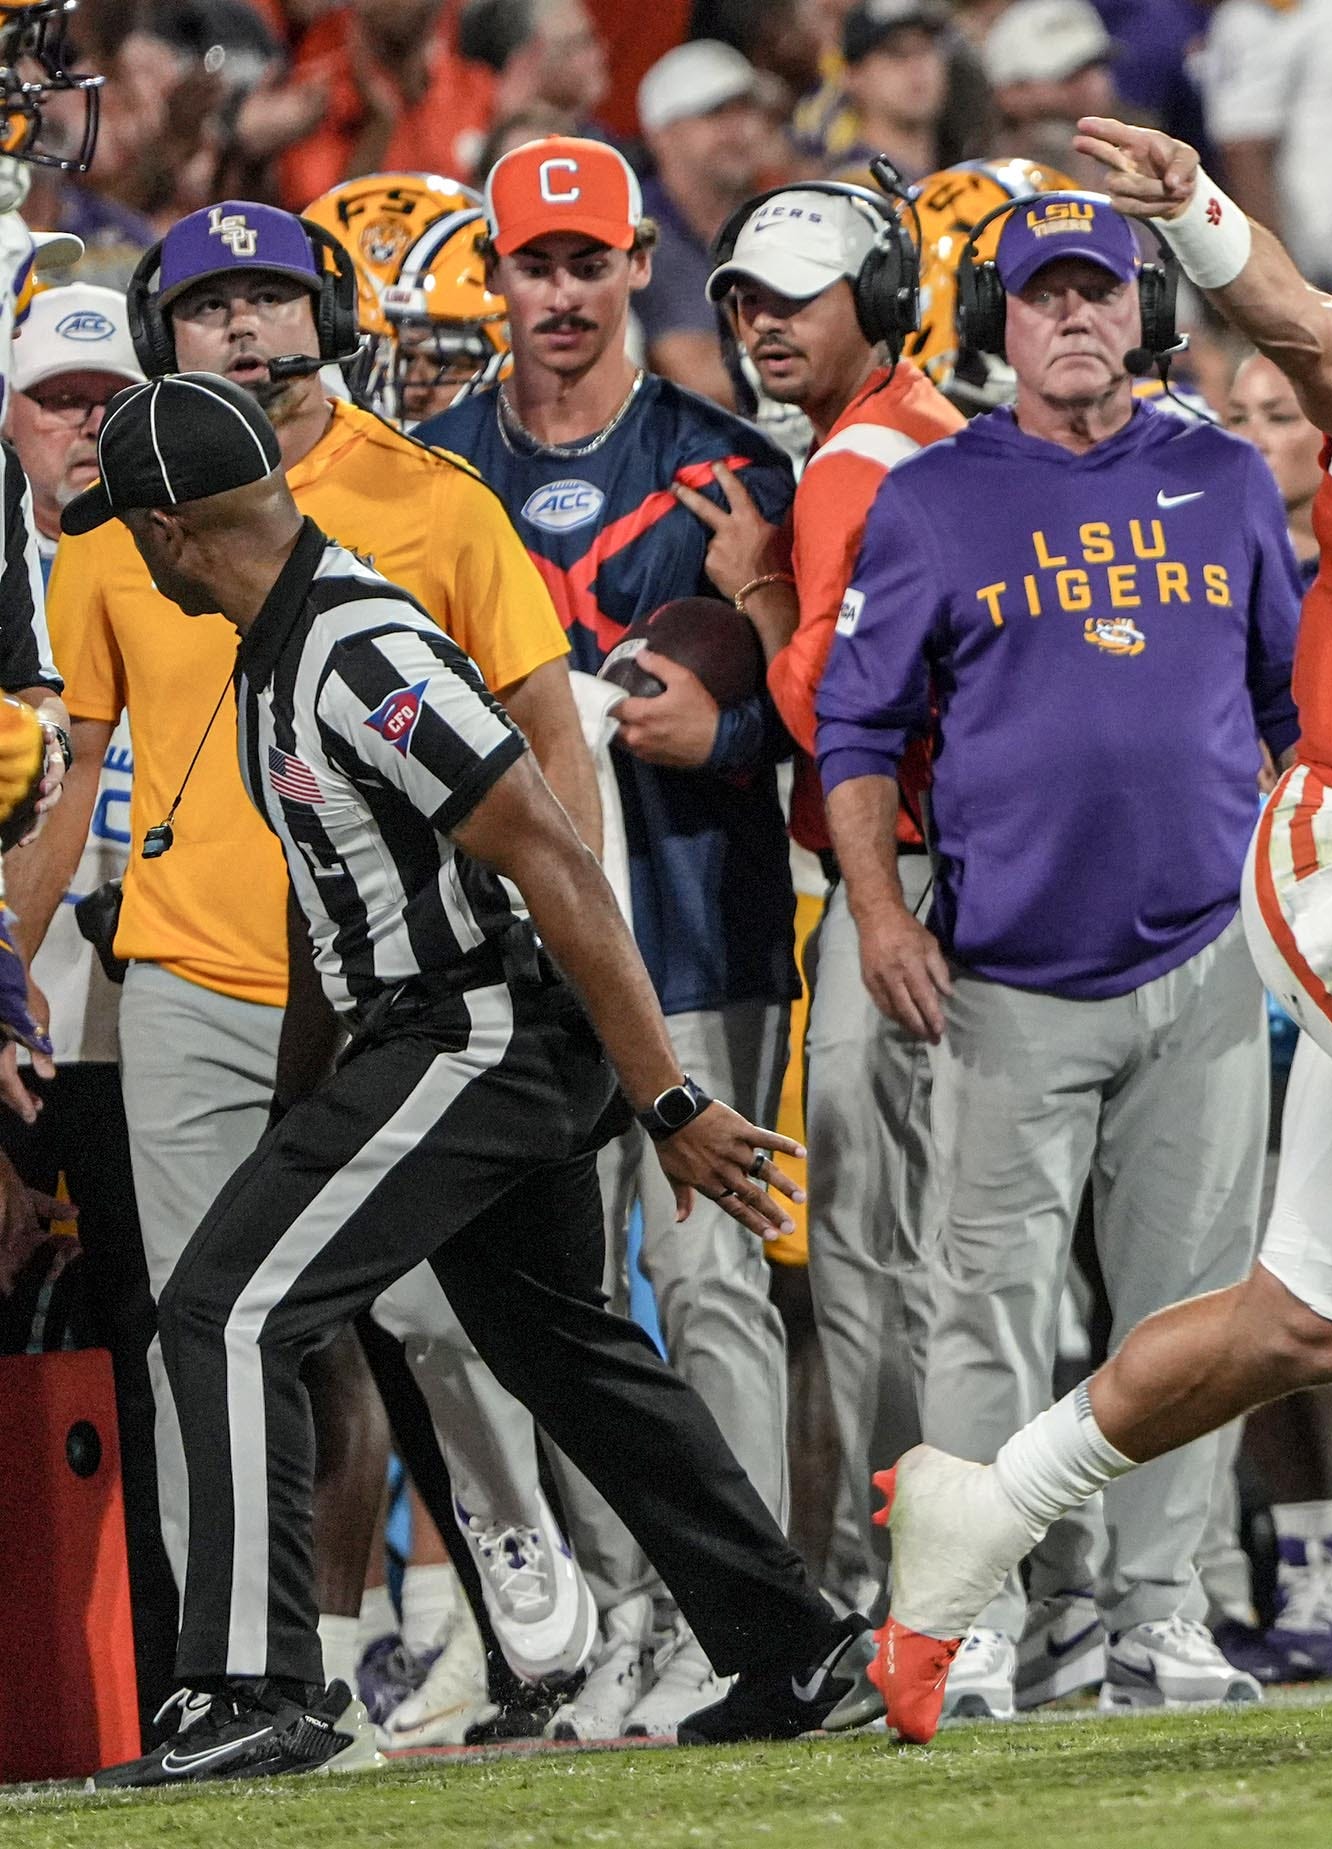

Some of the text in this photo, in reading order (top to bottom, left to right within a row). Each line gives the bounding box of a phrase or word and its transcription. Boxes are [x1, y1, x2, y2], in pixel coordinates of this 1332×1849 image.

[540, 158, 581, 203] C
[208, 206, 257, 256] LSU
[1026, 202, 1094, 229] LSU
[64, 317, 107, 333] ACC
[536, 491, 593, 512] ACC
[1033, 519, 1167, 569] LSU
[977, 562, 1232, 627] TIGERS
[387, 705, 415, 733] CFO
